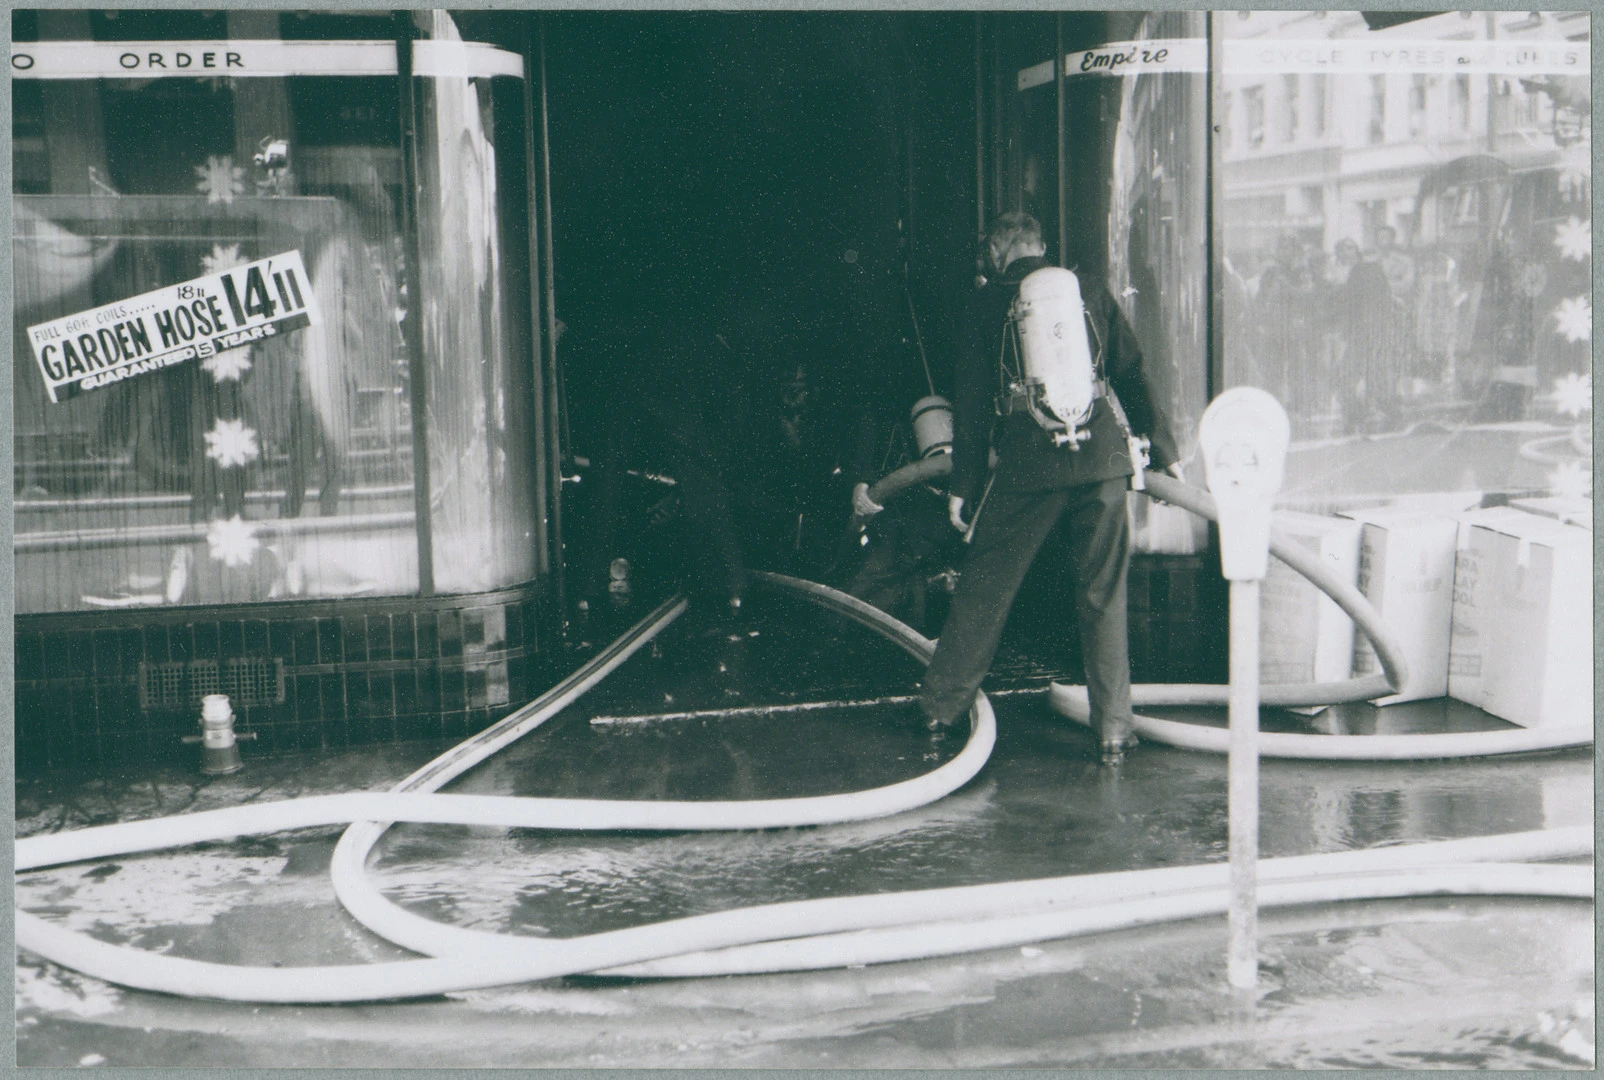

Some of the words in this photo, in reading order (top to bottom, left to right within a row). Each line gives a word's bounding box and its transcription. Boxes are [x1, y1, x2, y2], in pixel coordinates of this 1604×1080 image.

[119, 52, 244, 68] ORDER
[1080, 48, 1169, 72] Empire
[1257, 48, 1345, 65] CYCLE
[1368, 49, 1446, 66] TYRES
[34, 325, 61, 343] FULL
[41, 316, 153, 381] GARDEN
[153, 295, 229, 349] HOSE
[80, 347, 196, 390] GUARANTEED
[200, 342, 214, 356] 5
[217, 323, 276, 348] YEARS
